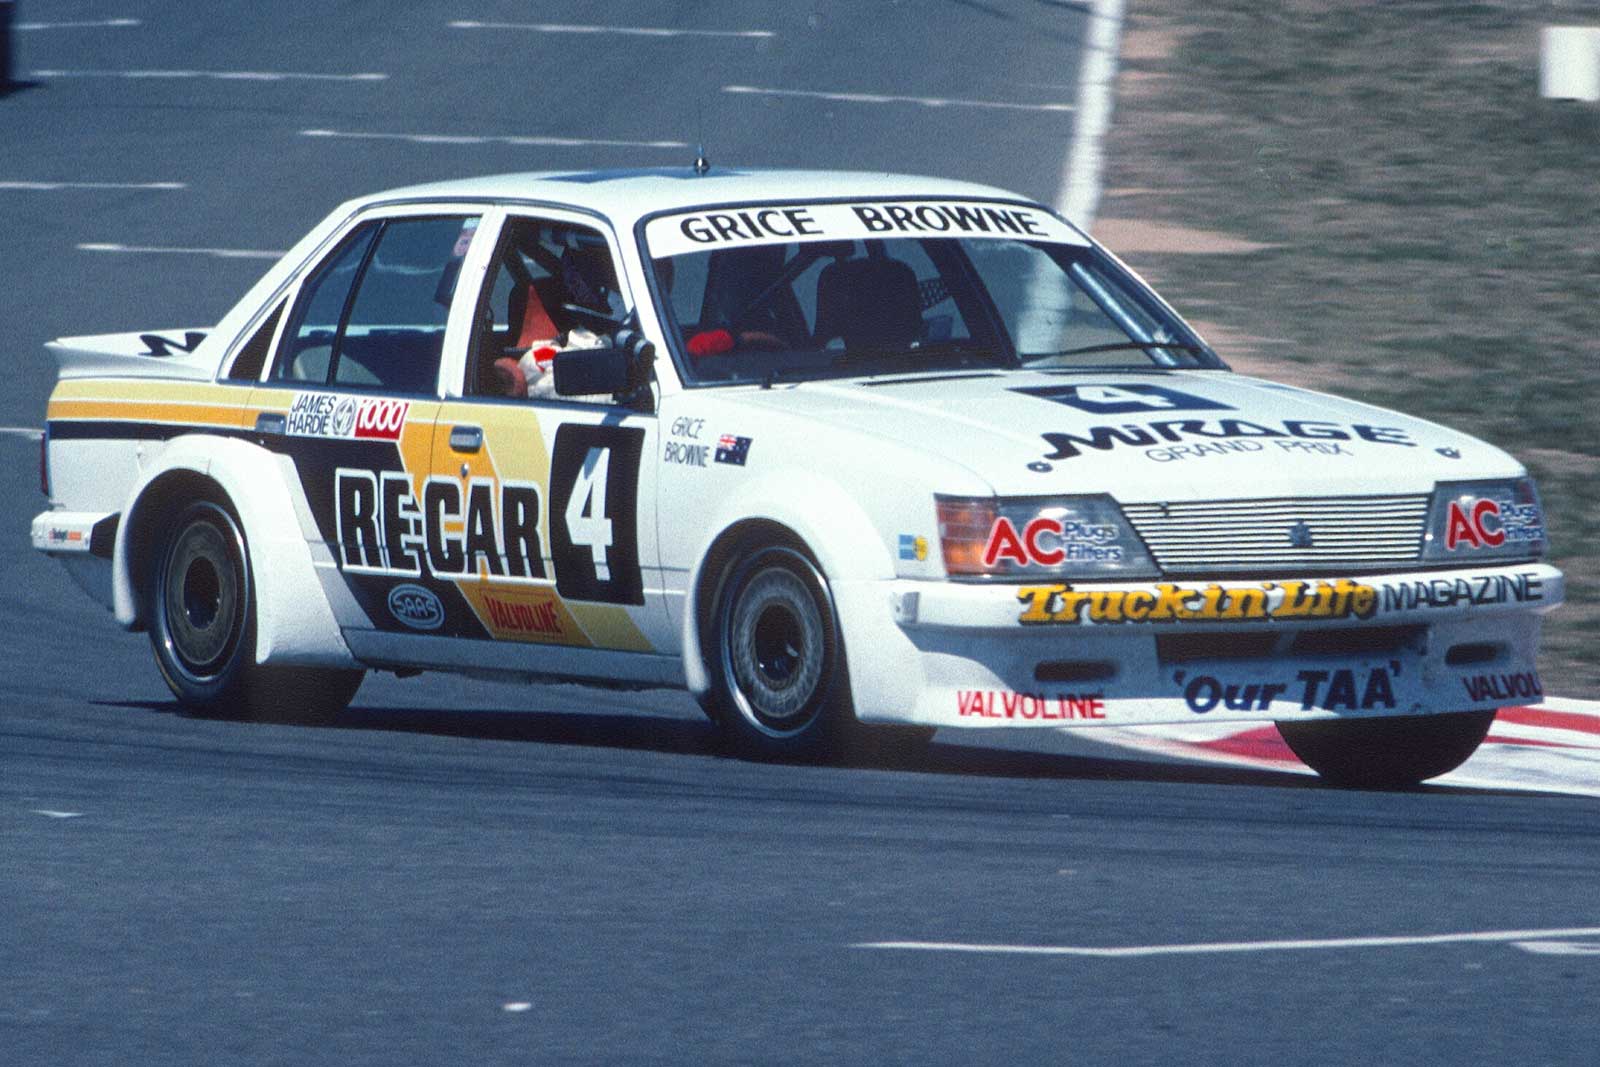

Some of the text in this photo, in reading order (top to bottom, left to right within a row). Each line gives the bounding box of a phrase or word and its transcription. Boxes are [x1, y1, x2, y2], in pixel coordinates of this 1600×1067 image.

[680, 205, 1049, 243] GRICE BROWNE
[292, 394, 337, 414] JAMES
[358, 400, 406, 432] 1000
[287, 413, 332, 435] HARDIE
[671, 416, 706, 439] GRICE
[664, 441, 710, 467] BROWNE
[1144, 438, 1354, 462] GRAND PRIX
[564, 447, 613, 581] 4
[1446, 499, 1505, 550] AC
[984, 517, 1066, 567] AC
[1063, 521, 1118, 543] Plugs
[1066, 543, 1122, 561] Filters
[395, 597, 438, 618] SAAS
[1271, 578, 1378, 620] Life
[1382, 572, 1544, 612] MAGAZINE
[483, 595, 563, 634] VALVOLINE
[957, 690, 1106, 719] VALVOLINE
